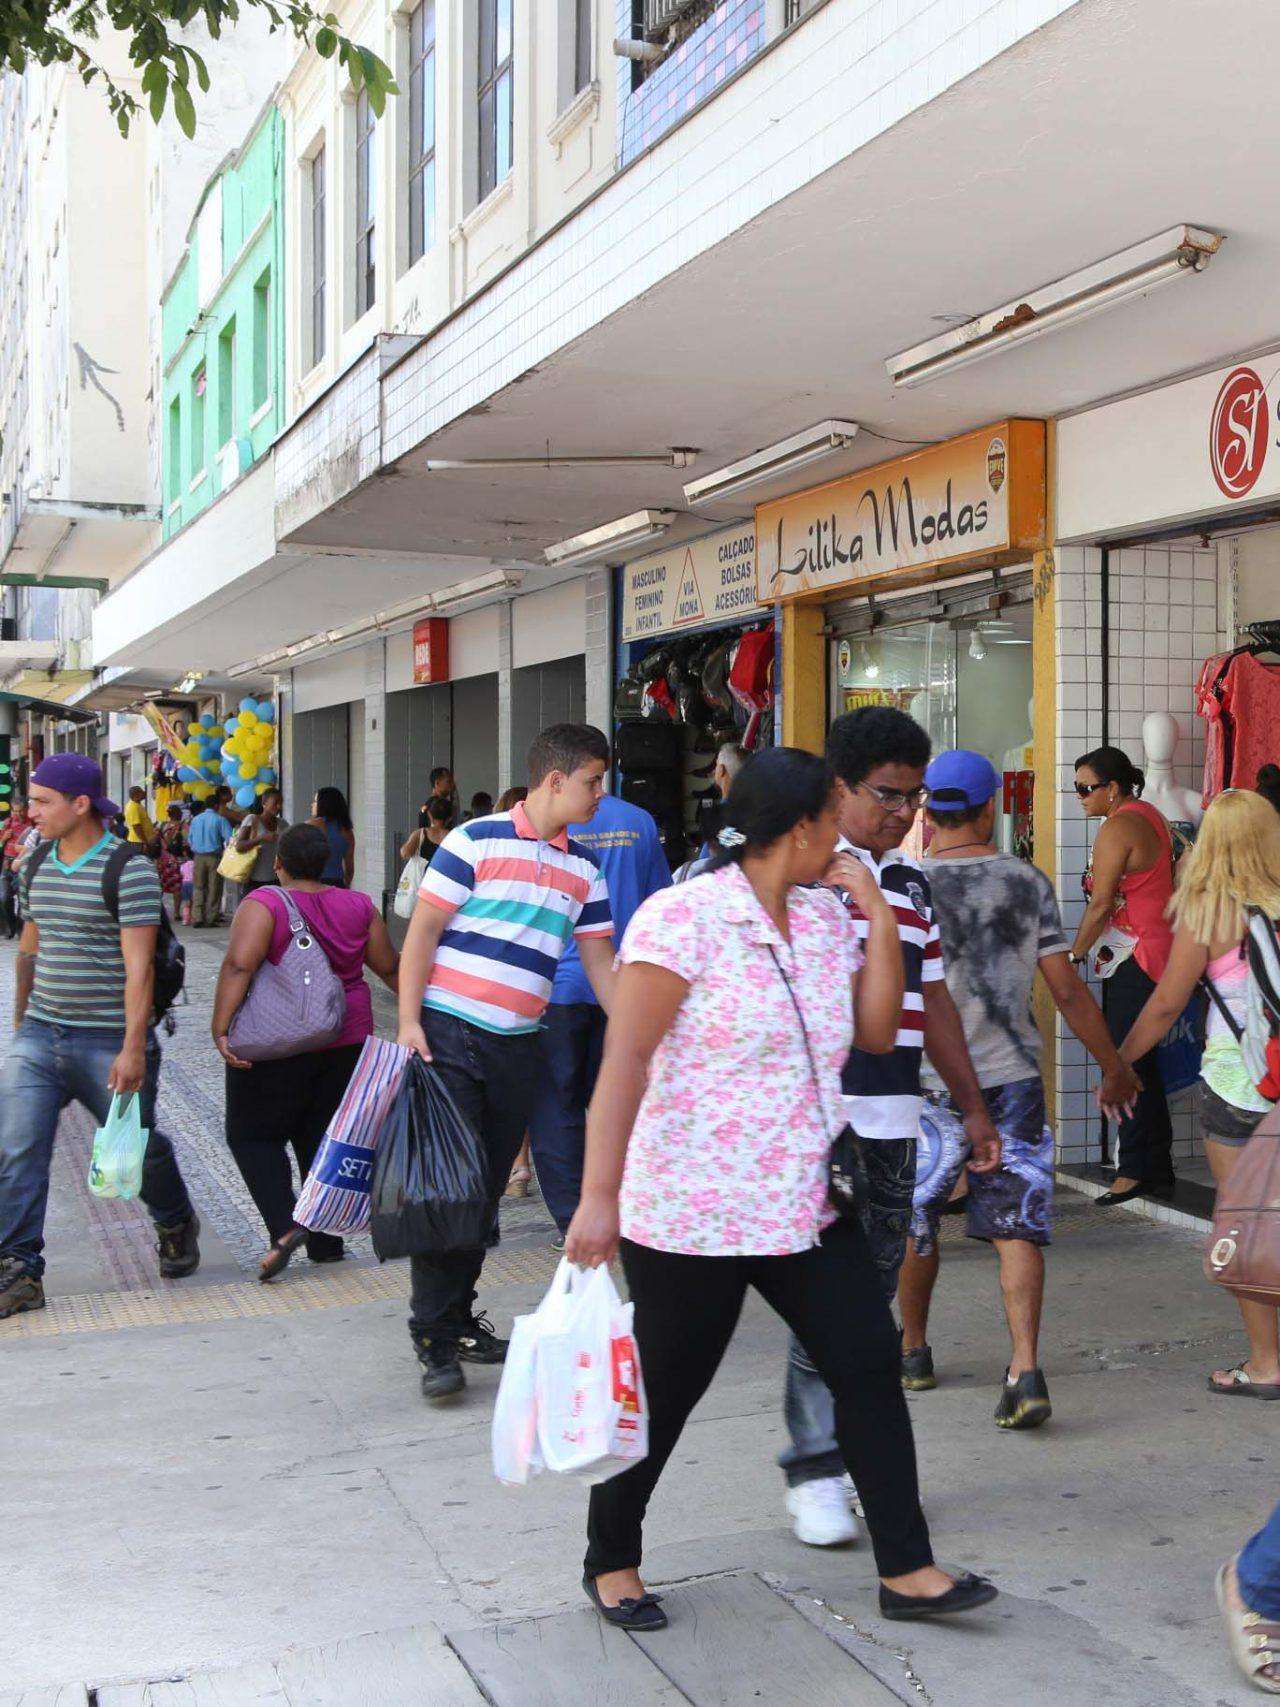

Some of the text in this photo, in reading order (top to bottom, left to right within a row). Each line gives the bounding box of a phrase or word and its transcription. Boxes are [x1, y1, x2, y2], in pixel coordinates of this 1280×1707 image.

[770, 476, 988, 584] Lilika Modas
[632, 566, 666, 590] MASCULINO
[721, 561, 751, 586] BOLSAS
[683, 581, 694, 596] VIA
[634, 590, 664, 611] FEMININO
[679, 601, 699, 617] MONA
[635, 612, 663, 632] INFANTIL
